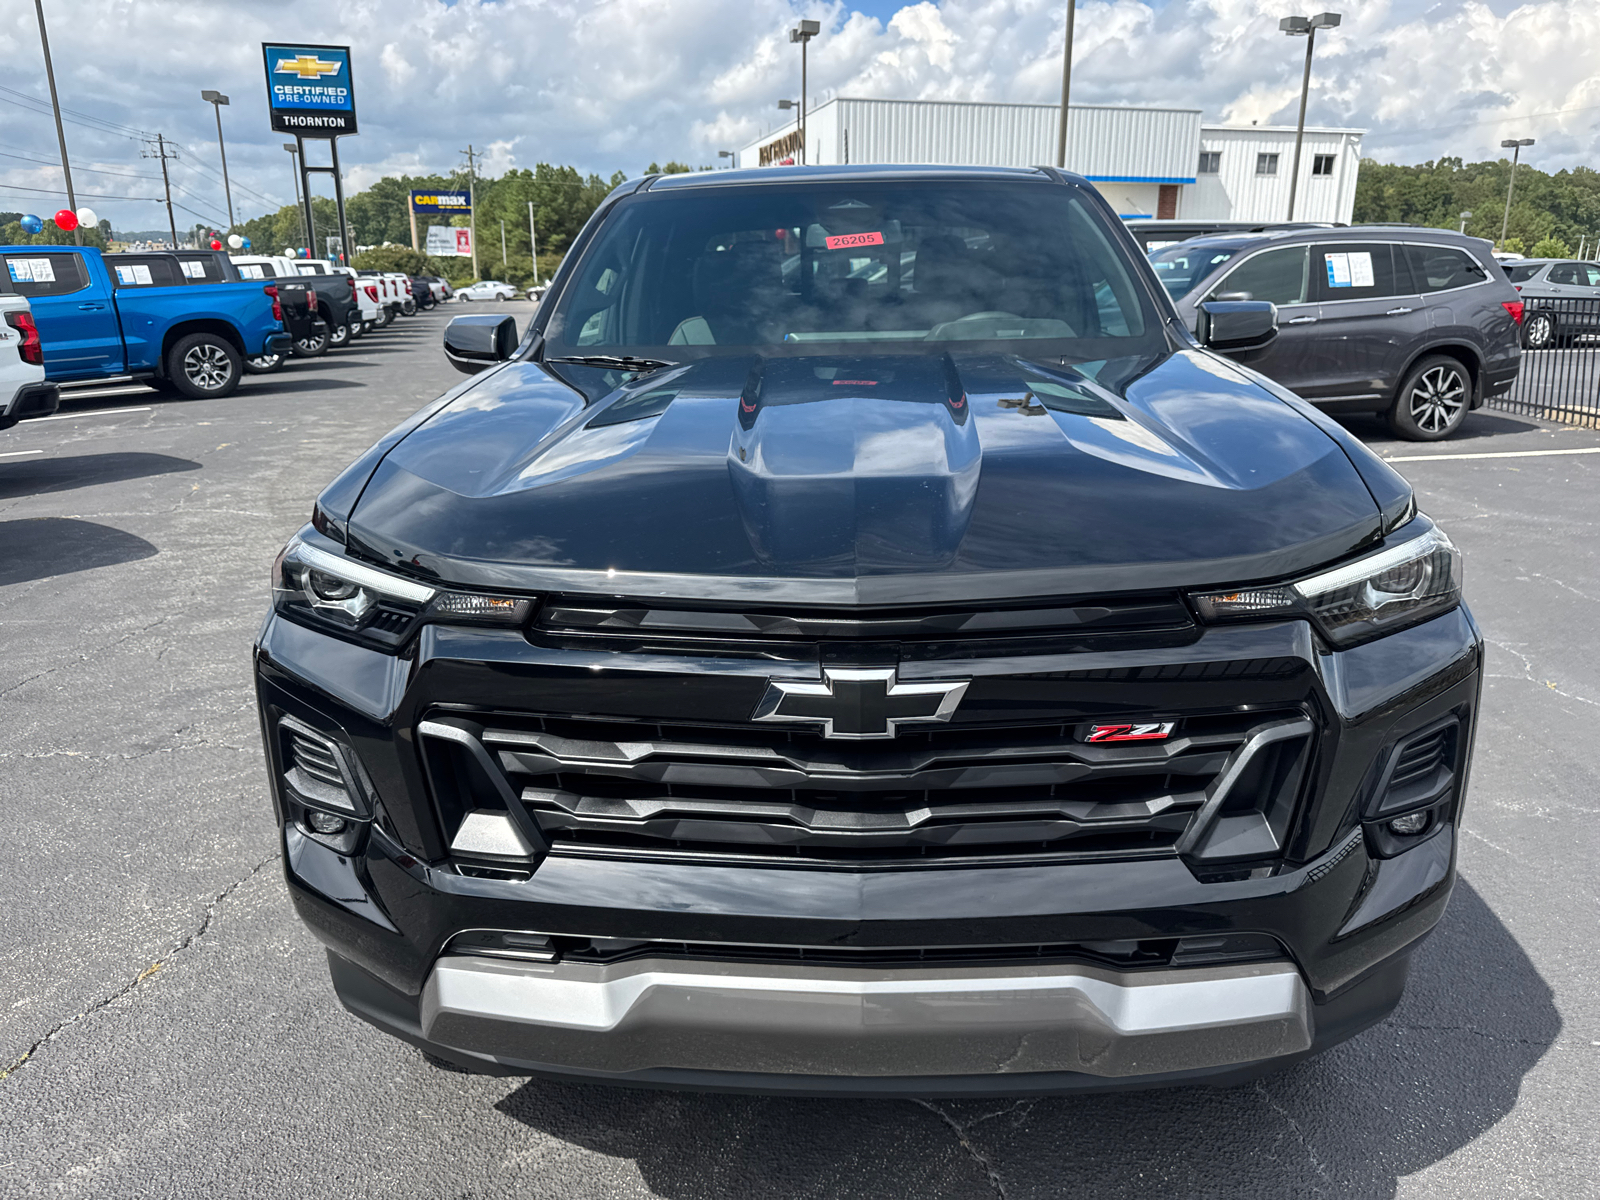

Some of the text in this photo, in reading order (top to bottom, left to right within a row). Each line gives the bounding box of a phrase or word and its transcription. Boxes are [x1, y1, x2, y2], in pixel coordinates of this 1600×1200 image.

[274, 85, 347, 96] CERTIFIED
[278, 94, 345, 104] PRE-OWNED
[282, 115, 346, 128] THORNTON
[832, 234, 875, 246] 26205
[1084, 722, 1175, 742] Z71
